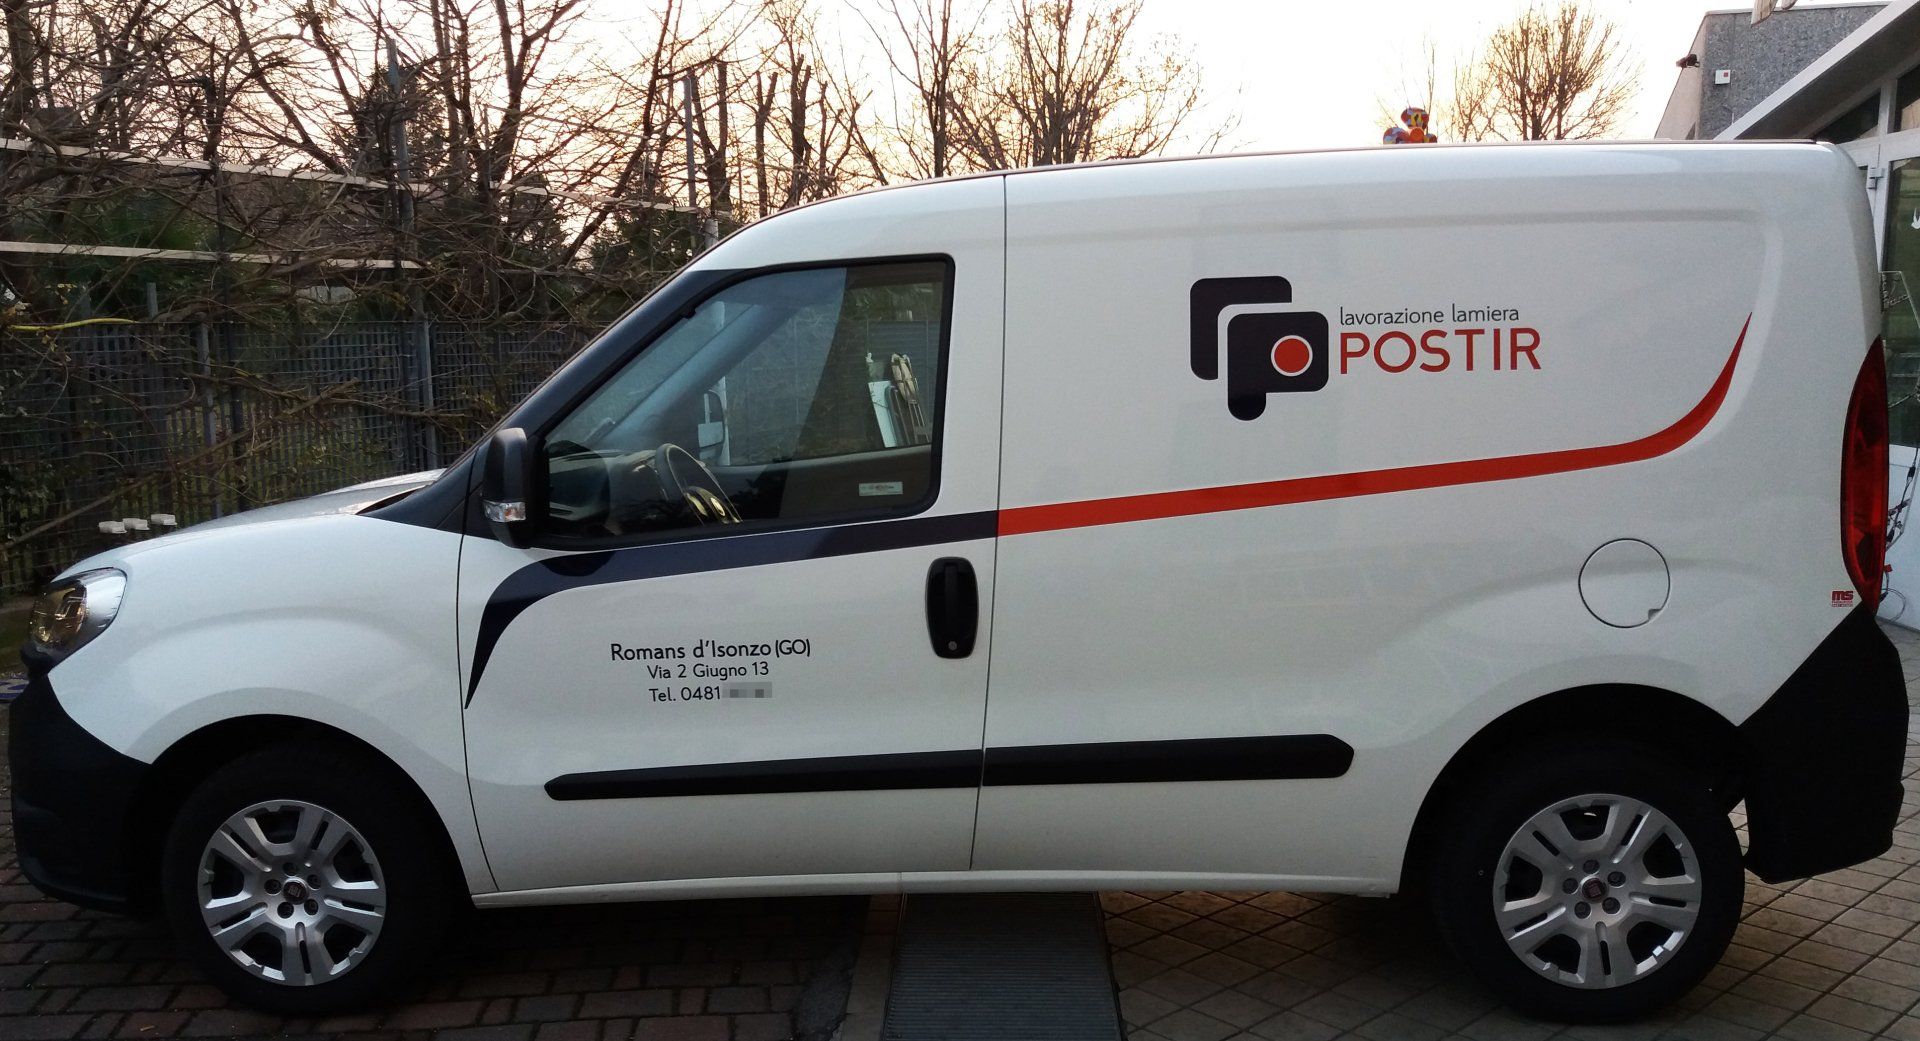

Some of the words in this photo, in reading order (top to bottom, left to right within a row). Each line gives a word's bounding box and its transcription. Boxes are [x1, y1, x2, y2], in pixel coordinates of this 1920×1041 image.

[1340, 306, 1444, 326] lavorazione
[1451, 303, 1520, 323] lamiera
[1340, 327, 1541, 375] POSTIR
[610, 643, 686, 661] Romans
[647, 664, 672, 679] Via
[677, 663, 687, 678] 2
[693, 663, 747, 681] Giugno
[751, 661, 769, 676] 13
[649, 687, 677, 702] Tel.
[680, 686, 721, 700] 0481
